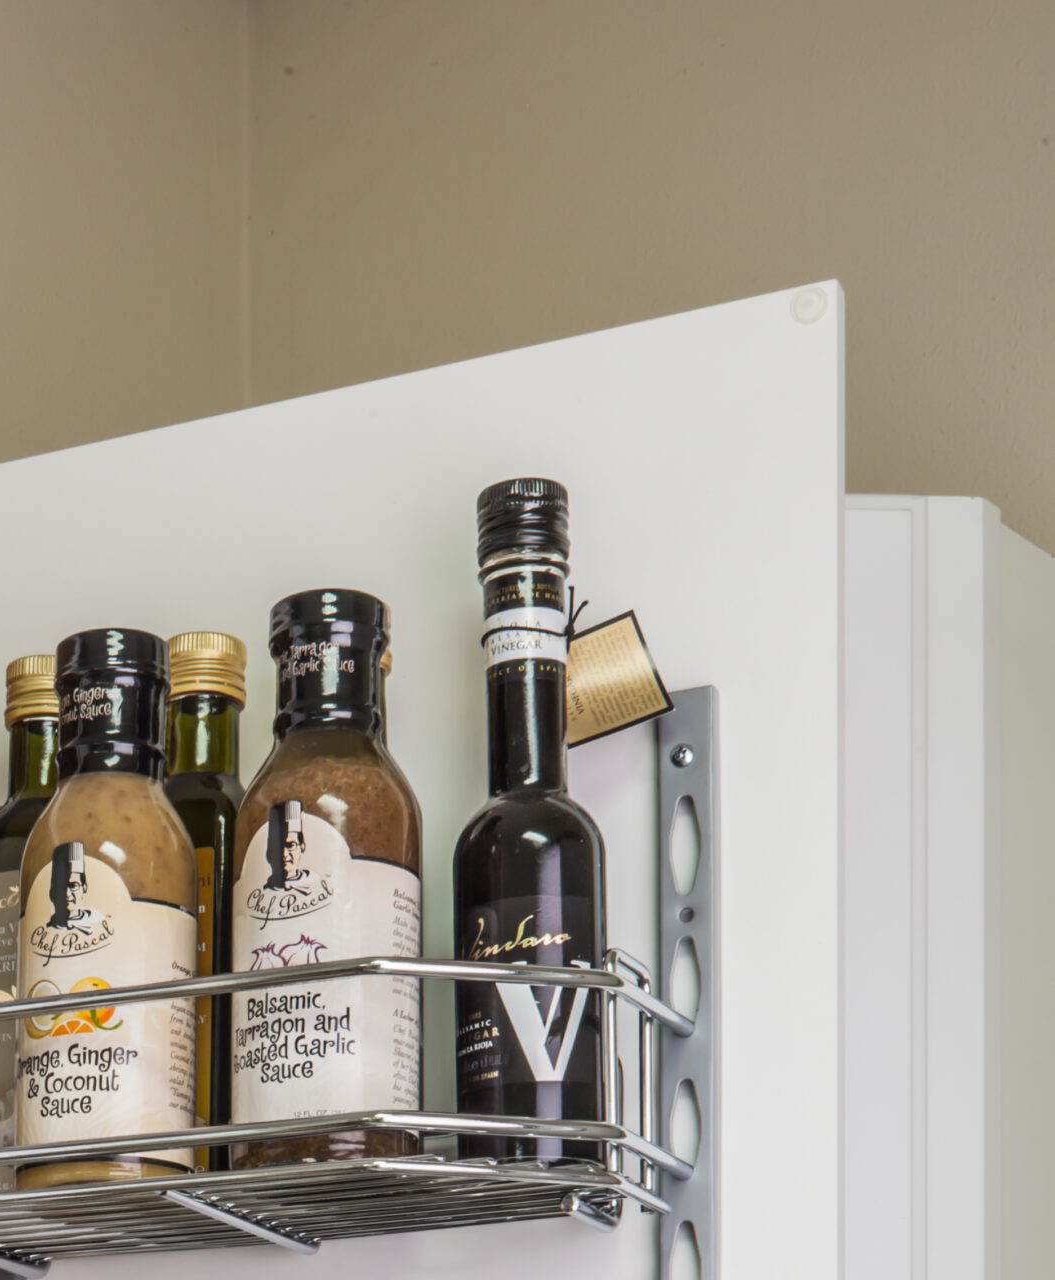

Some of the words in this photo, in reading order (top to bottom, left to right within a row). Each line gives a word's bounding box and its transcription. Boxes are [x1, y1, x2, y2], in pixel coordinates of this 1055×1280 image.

[491, 640, 544, 656] VINEGAR
[292, 657, 320, 677] Garlic
[73, 686, 107, 706] Ginger
[80, 701, 112, 721] Sauce
[246, 888, 275, 931] Chef
[278, 879, 334, 917] Pascal
[30, 926, 56, 967] Chef
[61, 919, 114, 955] Pascal
[247, 991, 326, 1021] Balsamic,
[2, 1031, 12, 1042] IN
[235, 1017, 305, 1048] Tarragon
[313, 1006, 351, 1034] and
[233, 1035, 288, 1074] Roasted
[294, 1033, 356, 1058] Garlic
[474, 1040, 493, 1051] RIOJA
[67, 1044, 139, 1073] Ginger
[27, 1078, 40, 1099] &
[44, 1069, 120, 1095] Coconut
[260, 1060, 313, 1084] Sauce
[481, 1070, 499, 1080] SPAIN
[39, 1095, 93, 1119] Sauce
